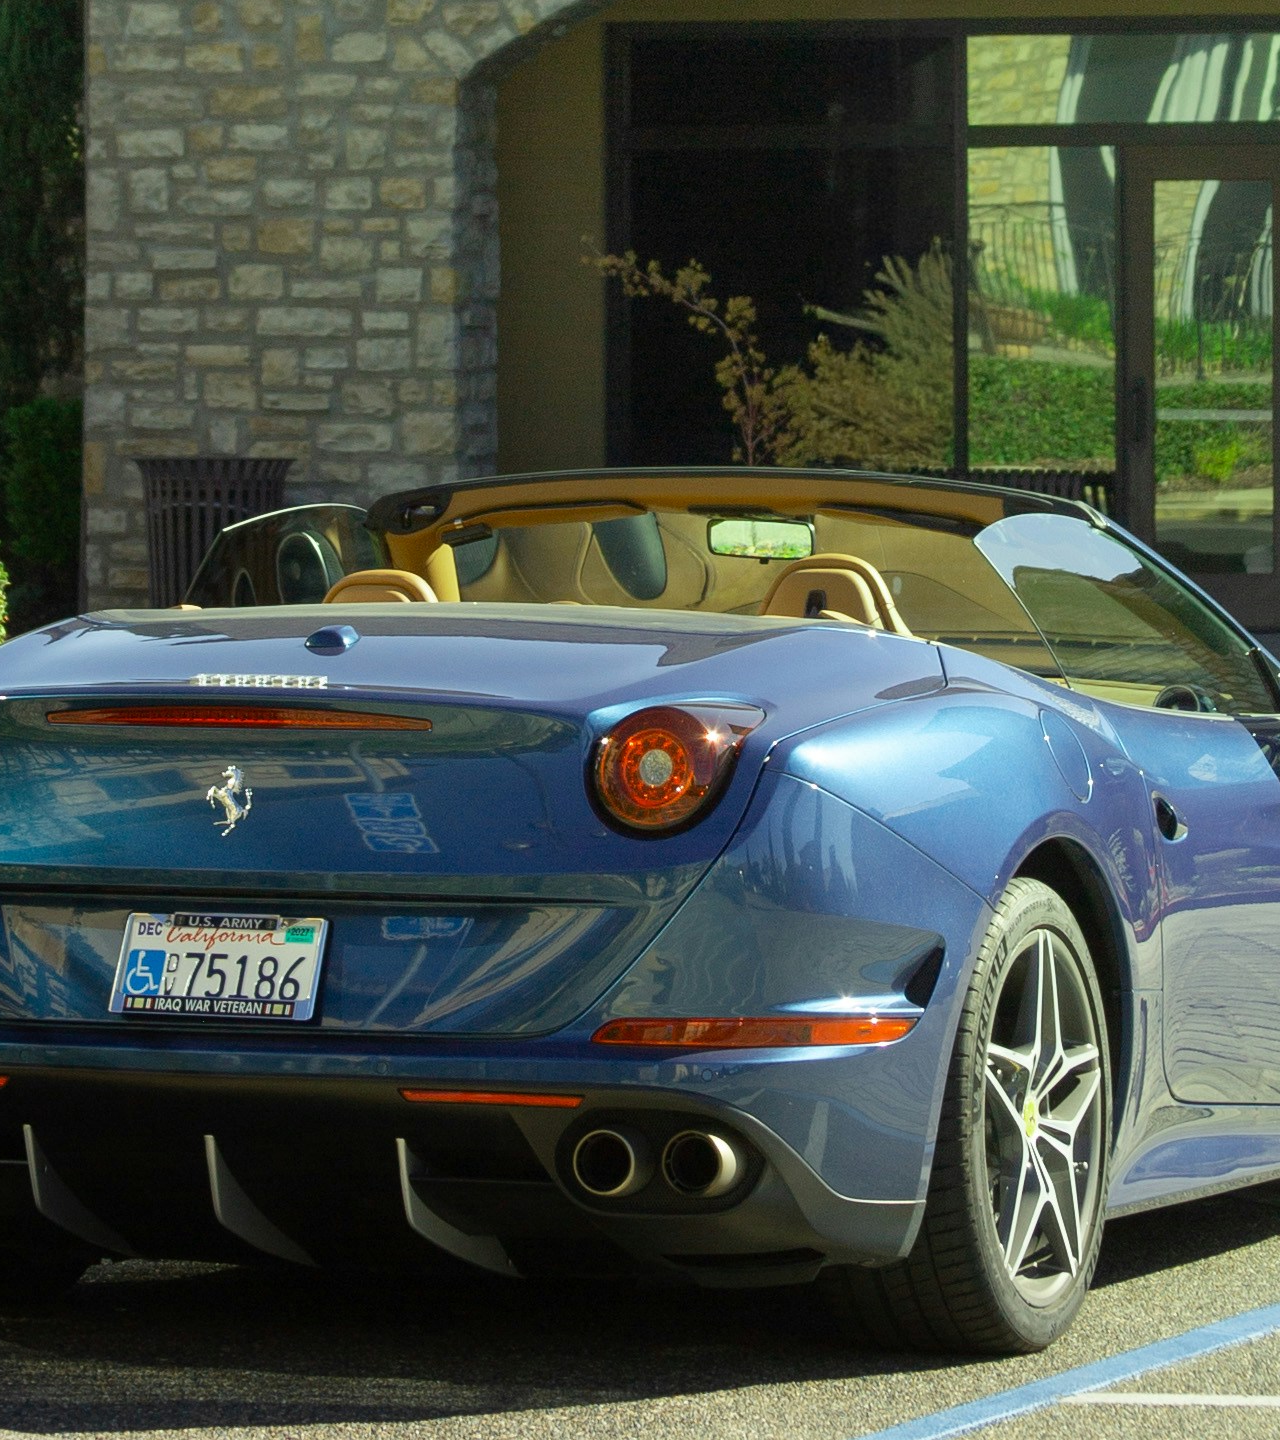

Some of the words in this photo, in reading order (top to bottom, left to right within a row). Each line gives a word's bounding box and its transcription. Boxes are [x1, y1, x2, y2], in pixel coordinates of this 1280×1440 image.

[137, 922, 163, 936] DEC
[188, 916, 214, 928] U.S.
[220, 917, 263, 929] ARMY
[166, 926, 286, 951] California
[184, 952, 306, 1000] 75186
[153, 998, 182, 1011] IRAQ
[185, 999, 210, 1012] WAR
[212, 1000, 263, 1014] VETERAN
[974, 936, 1008, 1079] MICHELIN
